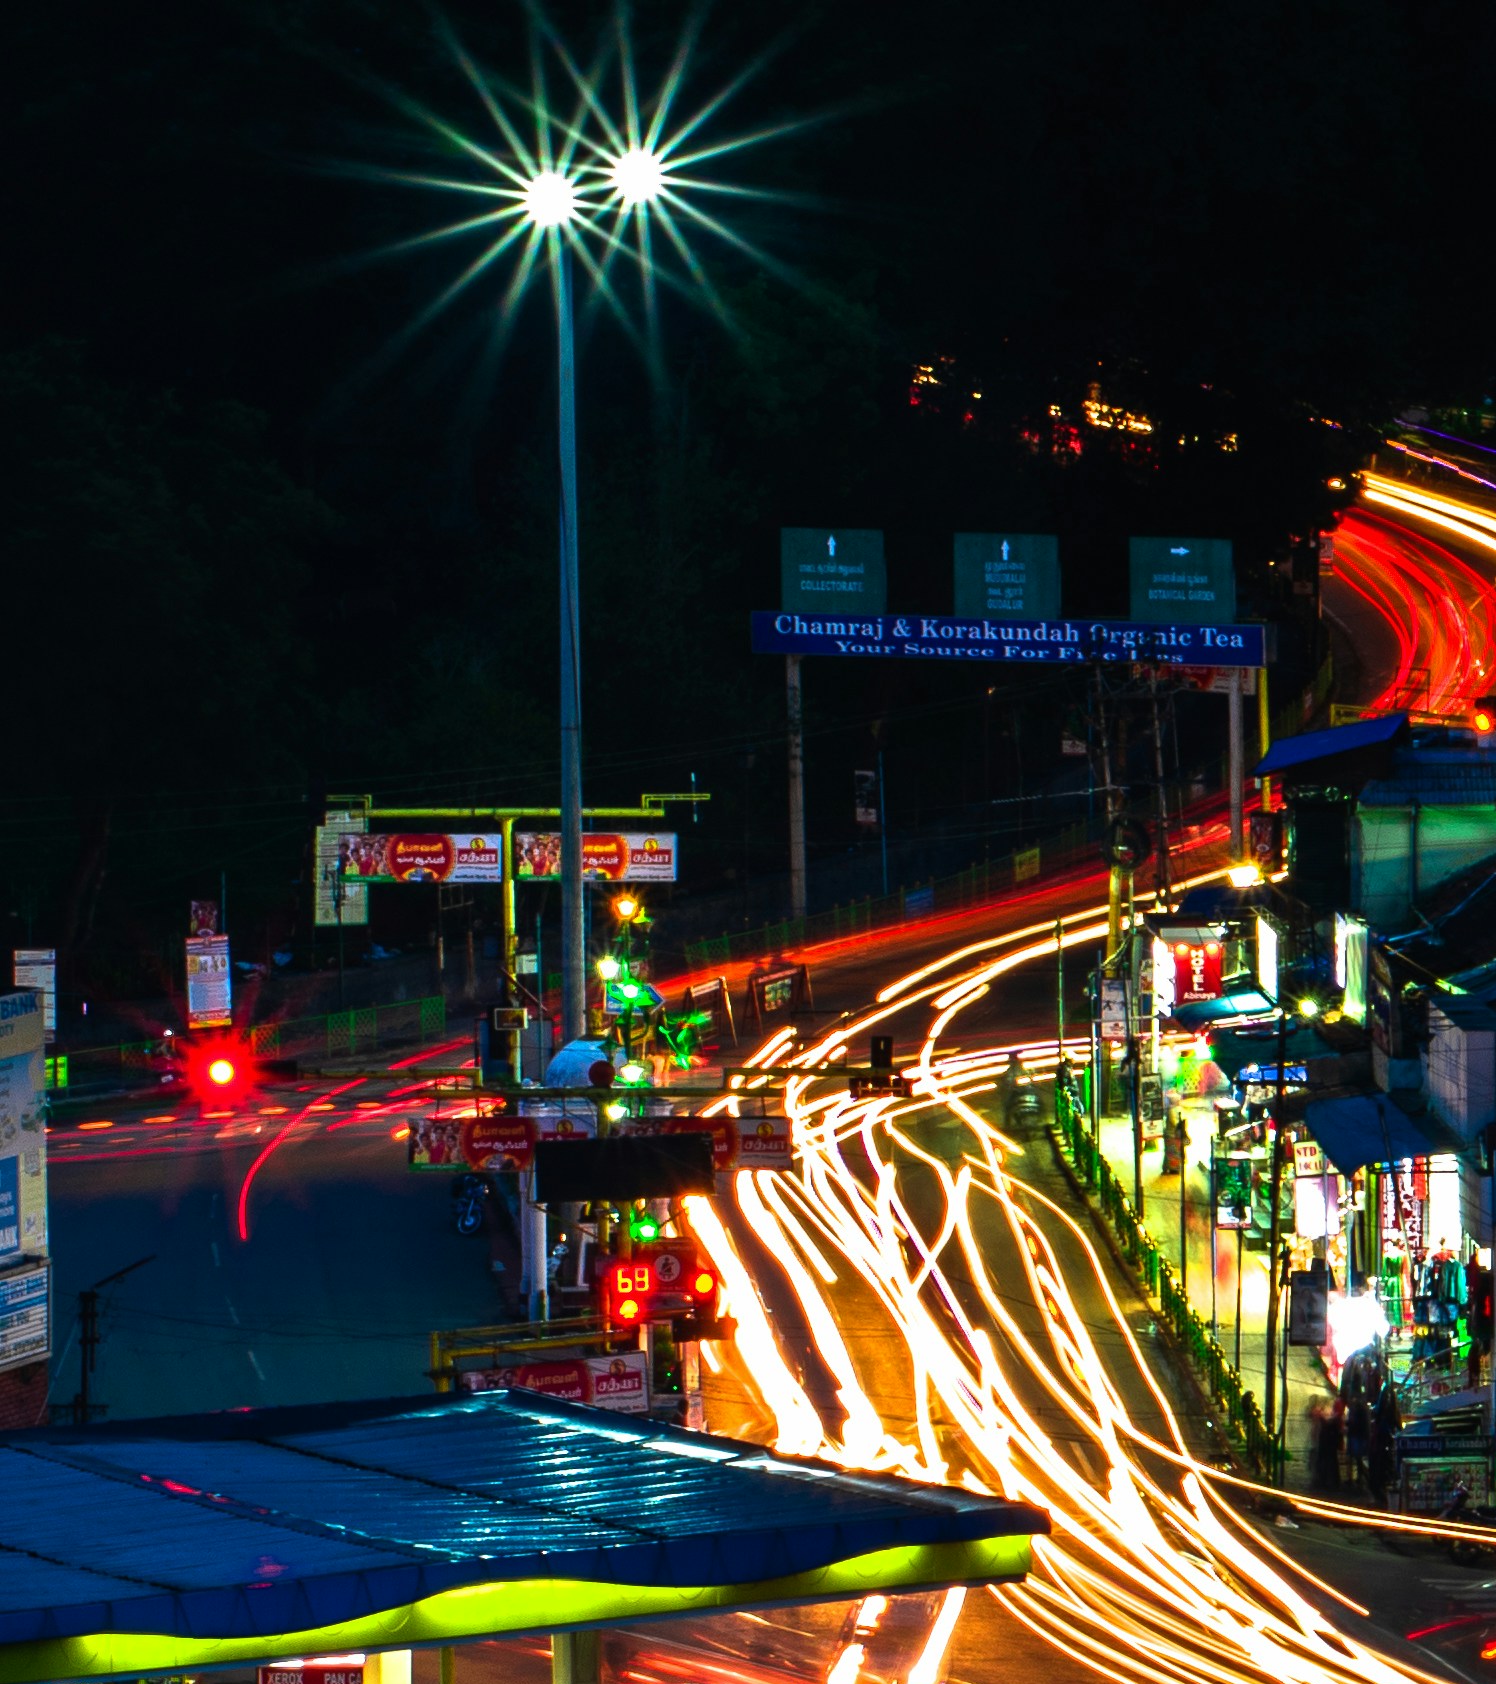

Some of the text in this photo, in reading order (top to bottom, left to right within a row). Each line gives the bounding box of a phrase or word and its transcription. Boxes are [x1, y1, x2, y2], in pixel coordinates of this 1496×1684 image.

[801, 580, 863, 593] COLLECTORATE
[774, 614, 1244, 648] Chamraj & Korakundah Tea
[835, 640, 1050, 660] Your Source For
